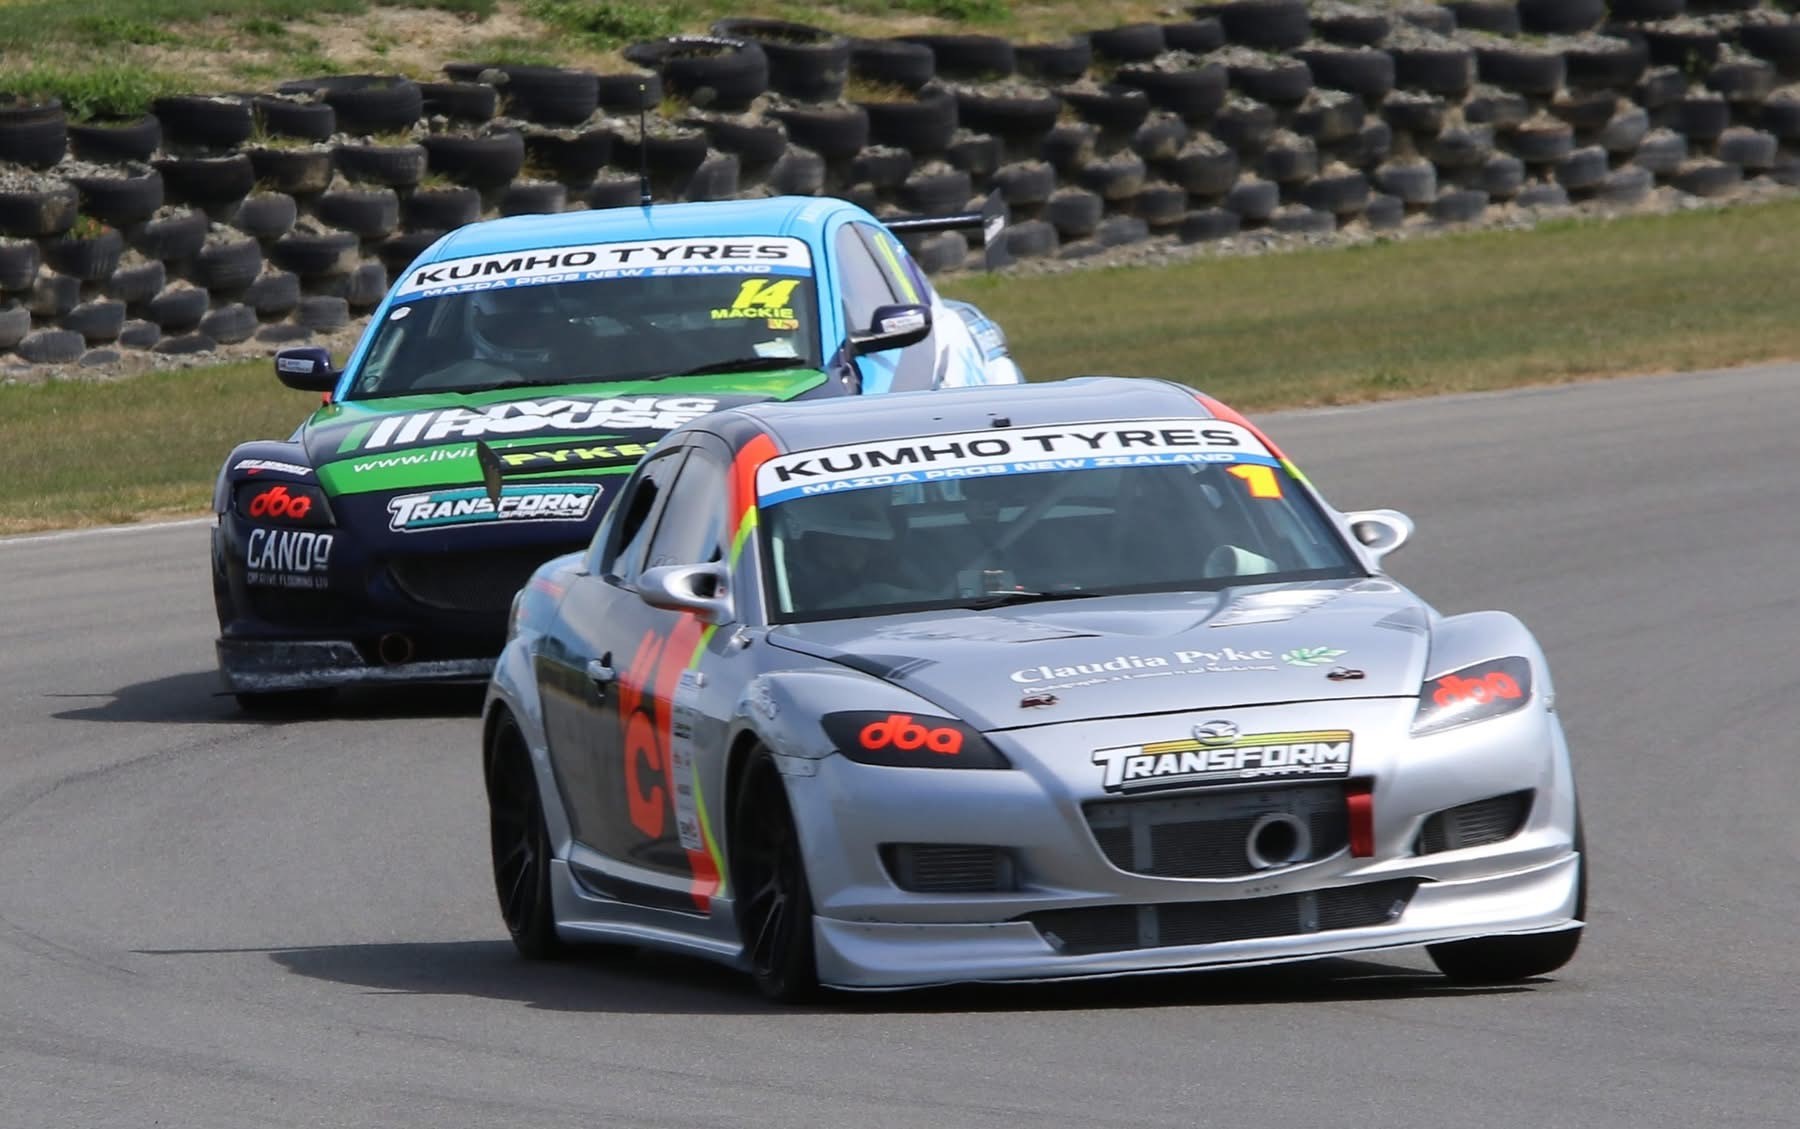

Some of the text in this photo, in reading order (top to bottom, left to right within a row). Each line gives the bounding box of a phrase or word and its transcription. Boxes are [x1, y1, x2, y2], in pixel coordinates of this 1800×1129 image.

[416, 244, 789, 286] KUMHO TYRES
[422, 278, 510, 297] MAZDA
[586, 268, 645, 280] NEW
[650, 264, 773, 276] ZEALAND
[731, 279, 800, 308] 14
[710, 308, 794, 319] MACKIE
[774, 429, 1240, 482] KUMHO TYRES
[801, 453, 1236, 495] MAZDA PROS NEW ZEALAND
[1225, 464, 1284, 500] 1
[249, 485, 312, 518] dba
[392, 494, 594, 527] TRANSFORM
[1009, 656, 1169, 683] Claudia
[1173, 647, 1273, 667] Pyke
[859, 704, 964, 755] dba
[1092, 742, 1352, 788] TRANSFORM
[1239, 763, 1350, 779] GRAPHICS
